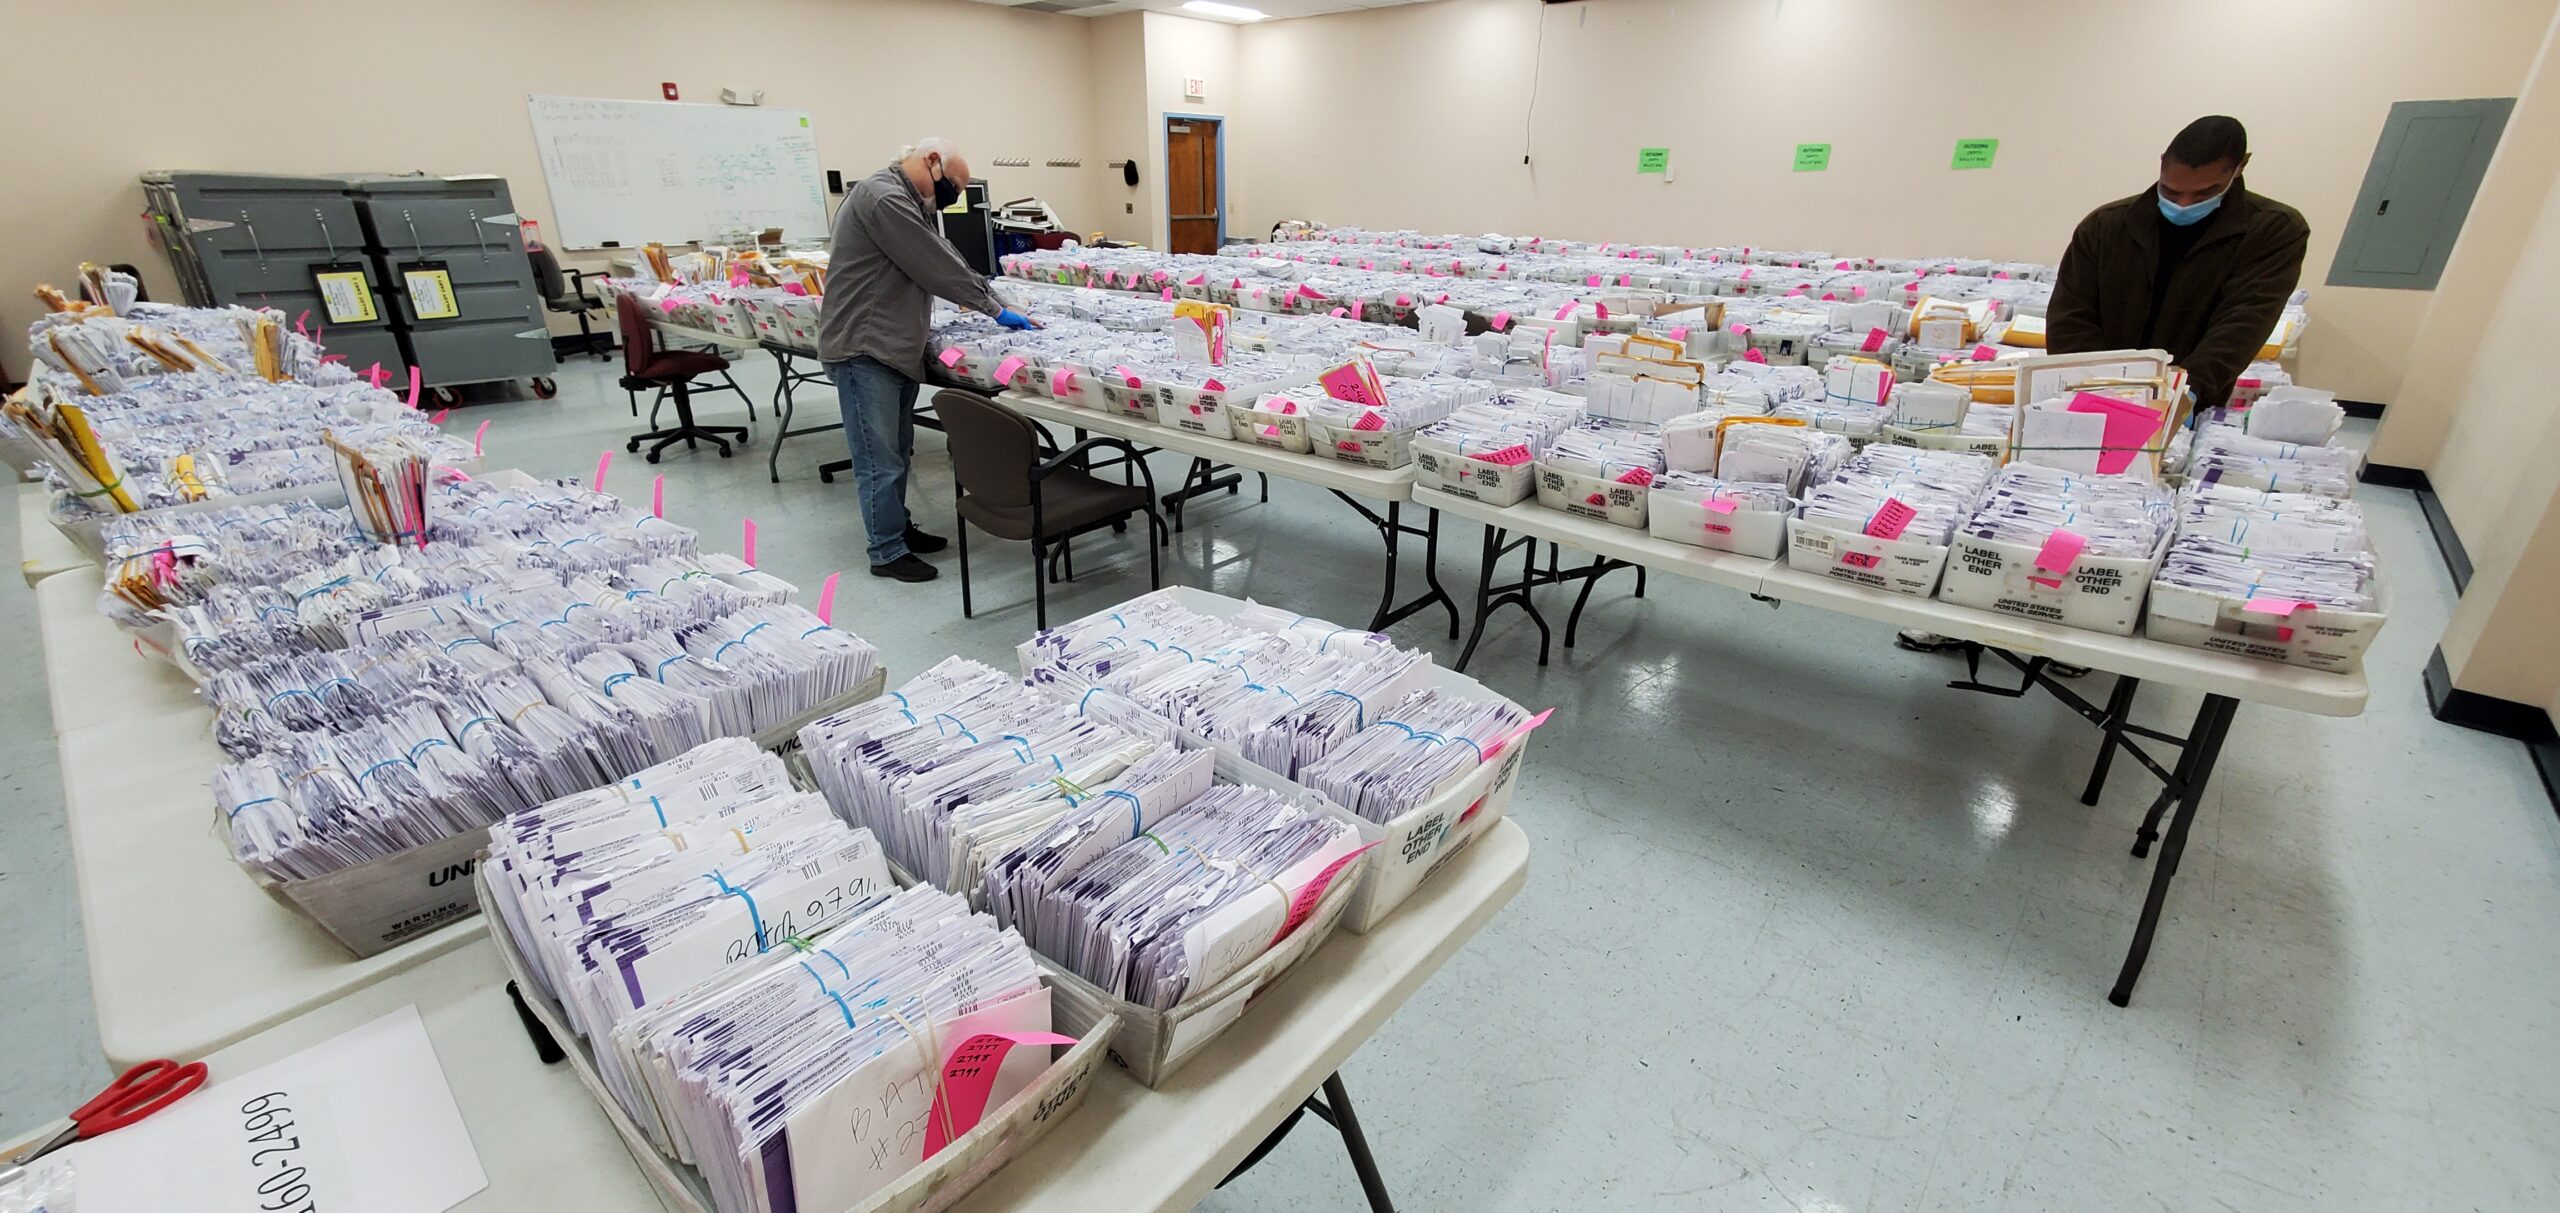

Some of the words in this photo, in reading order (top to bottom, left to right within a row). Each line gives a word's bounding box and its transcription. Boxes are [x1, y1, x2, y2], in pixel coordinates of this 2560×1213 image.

[1190, 80, 1203, 95] EXIT
[1200, 394, 1216, 402] LABEL
[1893, 433, 1918, 445] LABEL
[1418, 452, 1437, 463] LABEL
[1418, 457, 1439, 469] OTHER
[1422, 464, 1436, 473] END
[1478, 467, 1499, 477] LABEL
[1477, 473, 1501, 483] OTHER
[1543, 471, 1564, 482] LABEL
[1543, 476, 1565, 489] OTHER
[1547, 484, 1562, 492] END
[1610, 488, 1634, 496] LABEL
[1609, 493, 1635, 503] OTHER
[1614, 500, 1630, 508] END
[1965, 545, 2002, 561] LABEL
[1962, 555, 2002, 570] OTHER
[1832, 566, 1856, 577] UNITED
[1858, 571, 1885, 581] STATES
[1968, 564, 1993, 577] END
[2078, 566, 2123, 578] LABEL
[1829, 571, 1855, 580] POSTAL
[1856, 575, 1888, 587] SERVICE
[2075, 575, 2122, 588] OTHER
[2081, 585, 2110, 595] END
[1993, 603, 2025, 614] POSTAL
[2027, 609, 2065, 621] SERVICE
[1998, 598, 2029, 609] UNITED
[2030, 602, 2062, 614] STATES
[2203, 641, 2241, 652] POSTAL
[2244, 648, 2288, 660] SERVICE
[2209, 636, 2246, 647] UNITED
[2249, 642, 2288, 653] STATES
[1407, 812, 1445, 842] LABEL
[1402, 824, 1442, 855] OTHER
[1407, 841, 1431, 864] END
[391, 902, 457, 930] WARNING
[956, 1053, 991, 1064] 2798
[949, 1067, 981, 1078] 2799
